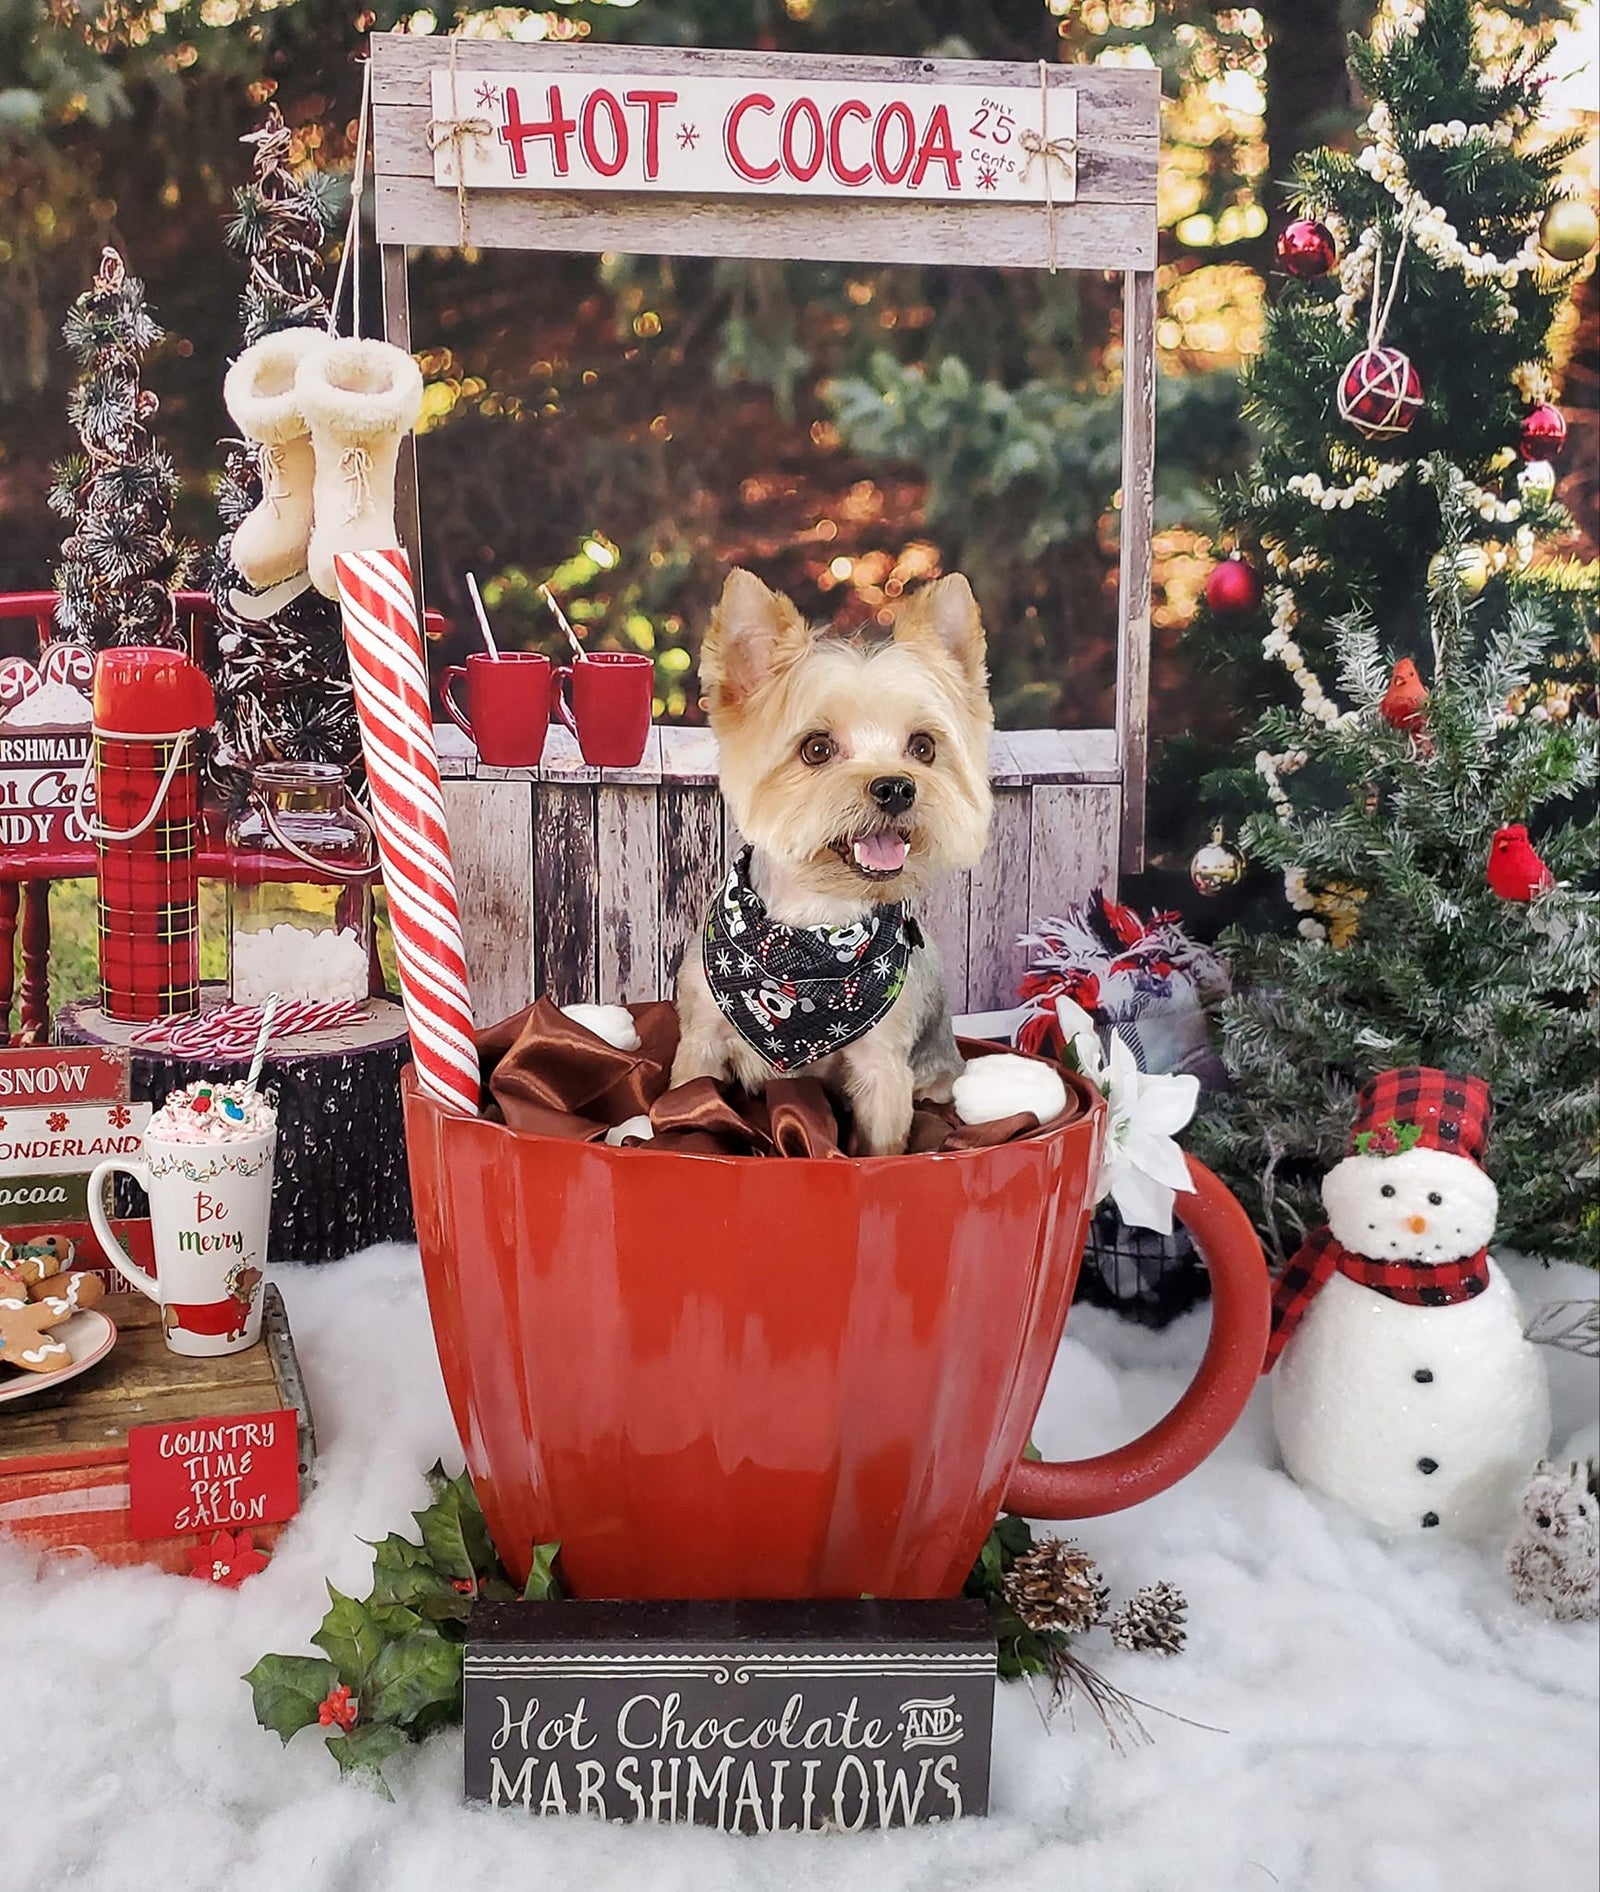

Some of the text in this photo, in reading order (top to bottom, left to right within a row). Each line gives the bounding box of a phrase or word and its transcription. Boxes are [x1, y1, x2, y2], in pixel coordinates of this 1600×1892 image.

[981, 97, 1013, 115] ONLY
[498, 85, 962, 190] HOT COCOA
[969, 108, 1016, 144] 25
[0, 1065, 90, 1095] SNOW
[193, 1190, 229, 1223] Be
[159, 1422, 275, 1458] COUNTRY
[183, 1450, 253, 1480] TIME
[190, 1476, 243, 1504] PET
[174, 1494, 267, 1530] SALON
[490, 1692, 956, 1752] Hot Chocolate AND
[489, 1754, 963, 1835] MARSHMALLOWS
